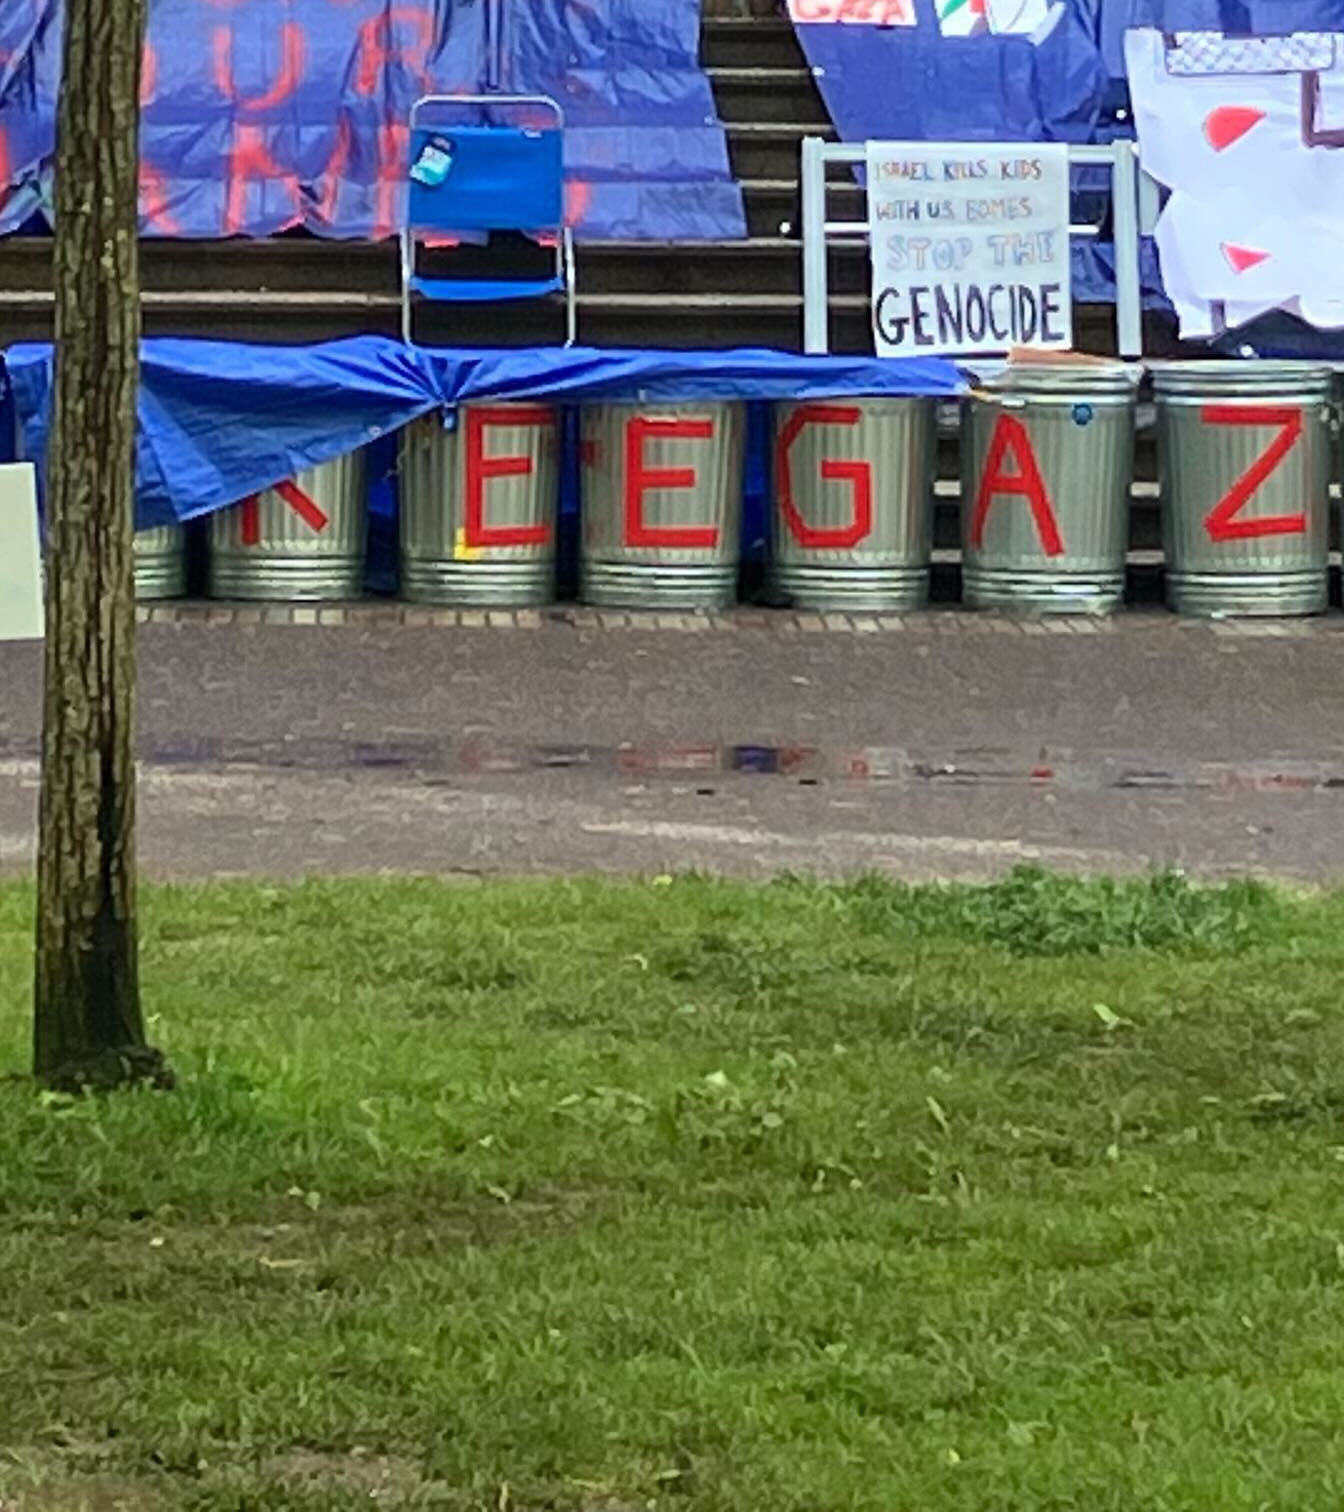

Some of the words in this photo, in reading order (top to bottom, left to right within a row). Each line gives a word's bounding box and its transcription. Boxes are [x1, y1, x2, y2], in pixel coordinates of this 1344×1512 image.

[942, 158, 989, 183] KILLS
[1000, 157, 1043, 182] KIDS
[875, 198, 921, 222] WITH
[885, 233, 974, 272] STOP
[986, 226, 1059, 267] THE
[875, 283, 1065, 347] GENOCIDE
